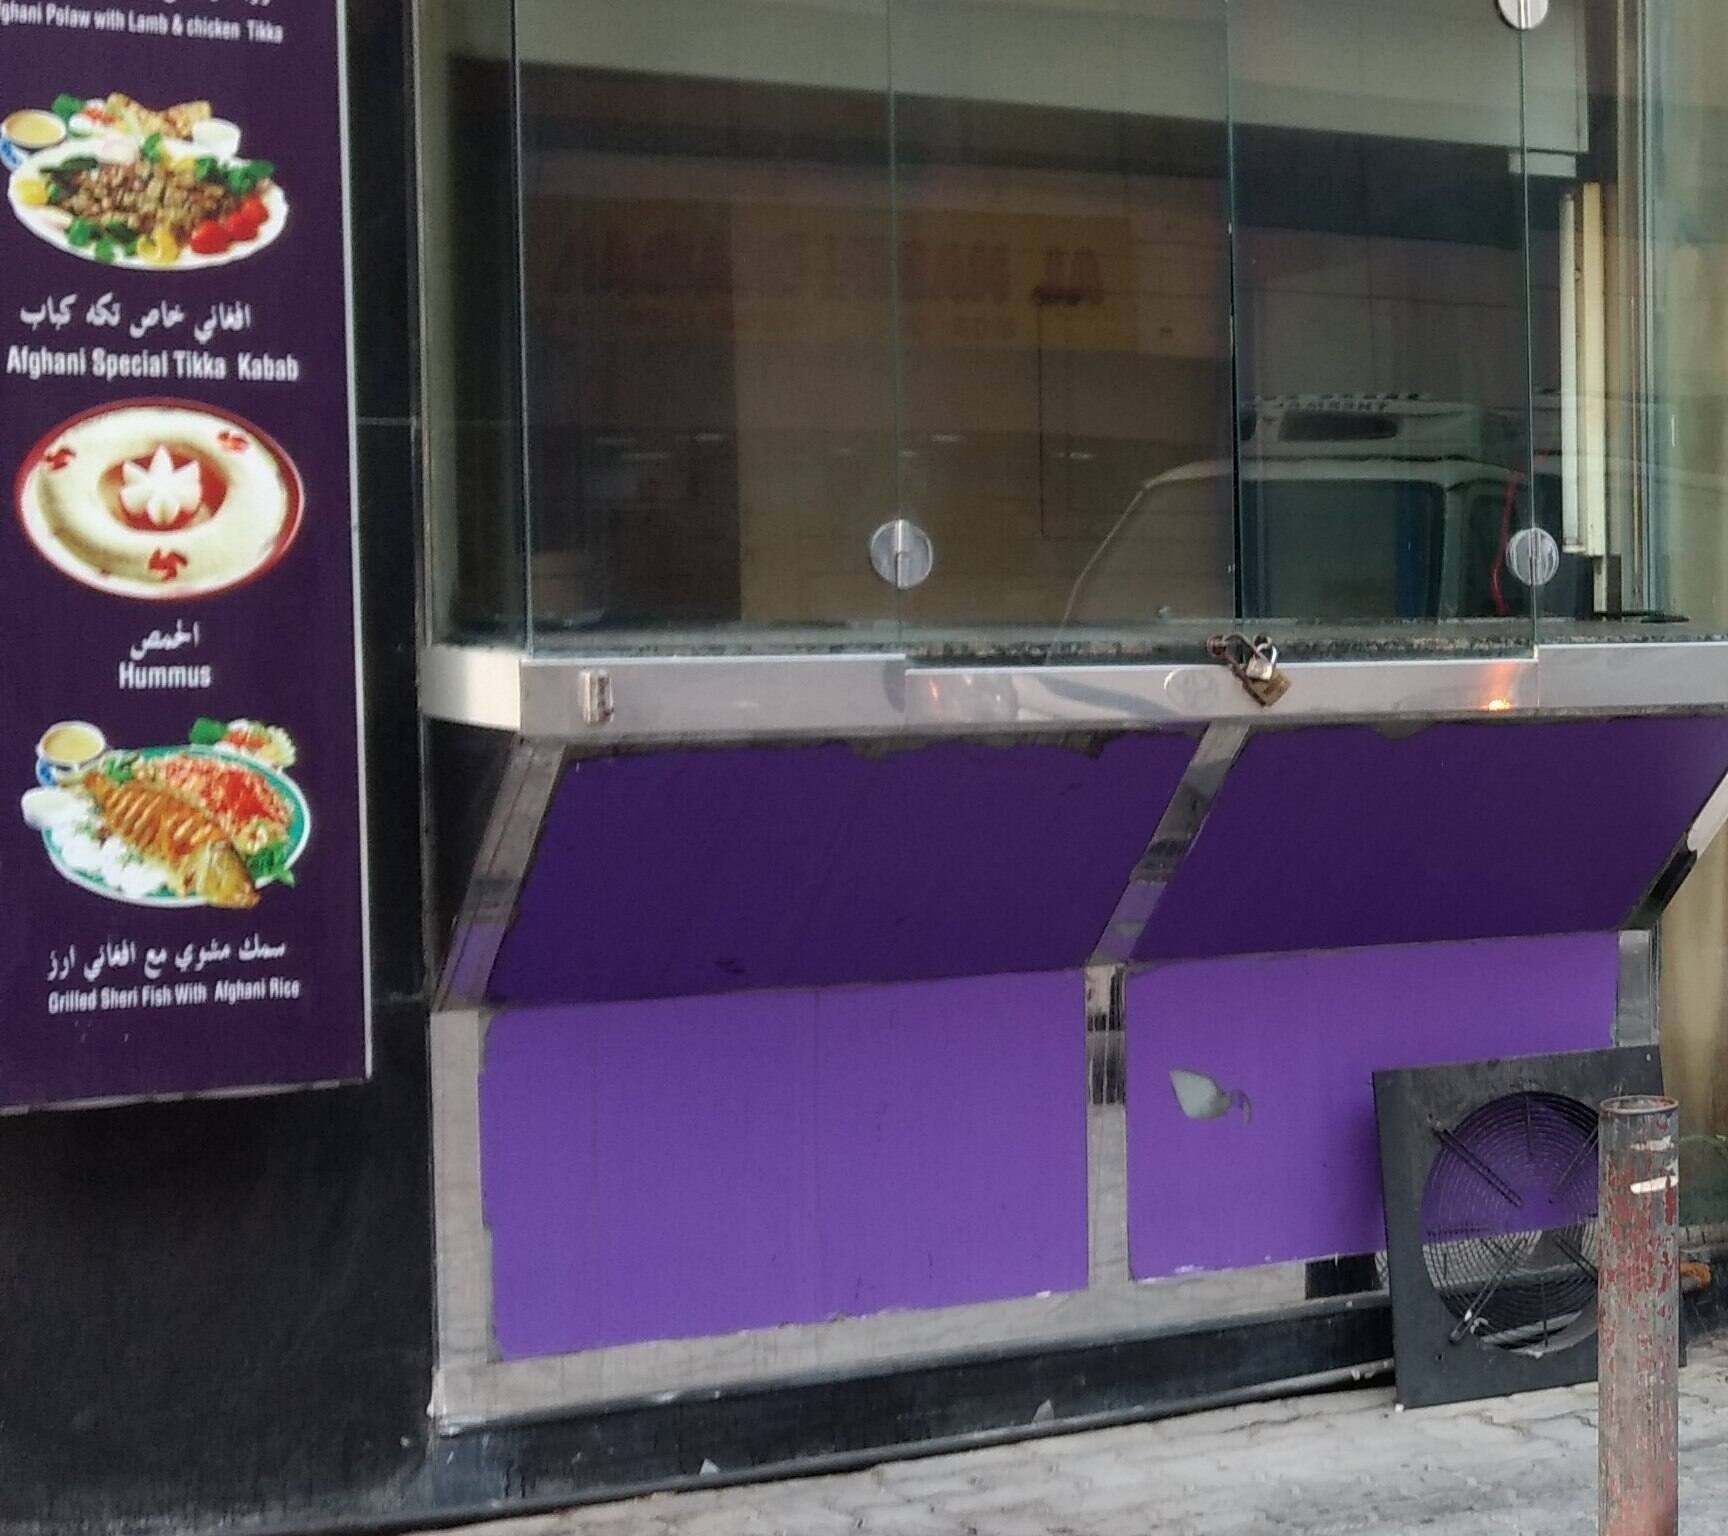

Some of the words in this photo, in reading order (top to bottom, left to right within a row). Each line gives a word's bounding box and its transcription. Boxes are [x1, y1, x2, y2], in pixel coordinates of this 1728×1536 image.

[46, 2, 91, 30] Polaw
[94, 7, 125, 32] with
[128, 10, 169, 35] Lamb
[171, 14, 184, 37] &
[186, 15, 241, 41] chicken
[246, 19, 284, 45] Tikka
[6, 344, 87, 381] Afghani
[92, 347, 169, 382] Special
[173, 349, 228, 380] Tikka
[237, 352, 300, 382] Kabab
[118, 661, 212, 690] Hummus
[144, 946, 168, 979] مع
[238, 932, 287, 962] سمك
[48, 989, 97, 1015] Grilled
[142, 983, 173, 1008] Fish
[175, 981, 208, 1007] With
[215, 977, 266, 1006] Afghani
[270, 975, 301, 1001] Rice
